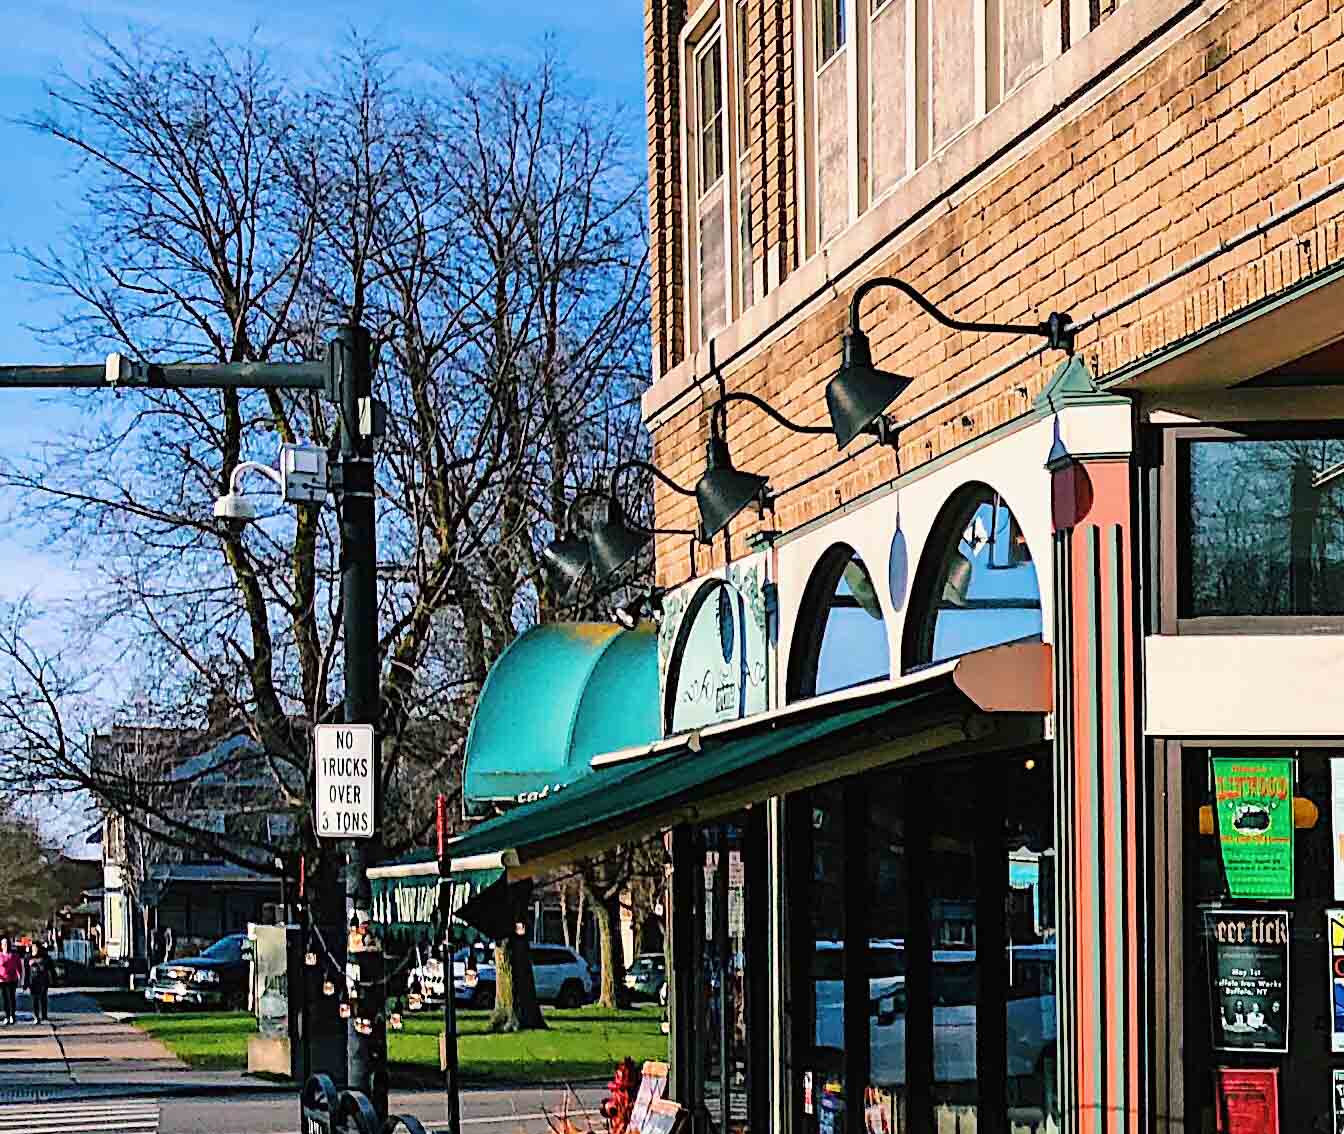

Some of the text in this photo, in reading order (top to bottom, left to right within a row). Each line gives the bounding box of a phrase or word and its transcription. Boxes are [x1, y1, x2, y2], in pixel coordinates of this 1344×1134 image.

[336, 731, 353, 749] NO
[322, 757, 368, 777] TRUCKS
[329, 785, 361, 804] OVER
[337, 811, 368, 831] TONS
